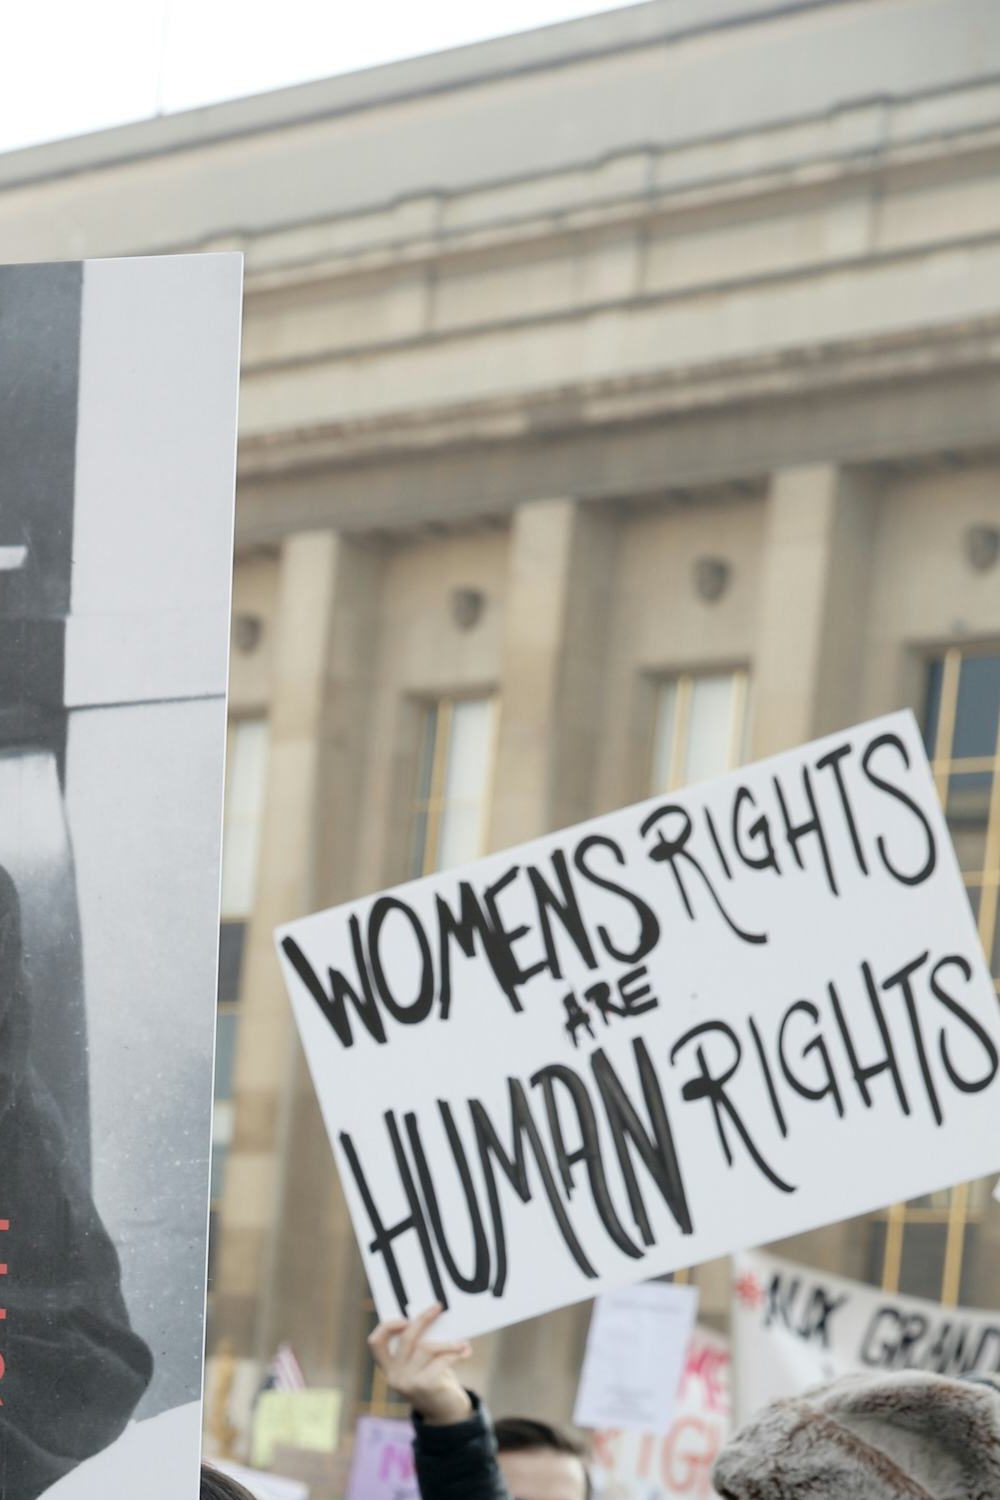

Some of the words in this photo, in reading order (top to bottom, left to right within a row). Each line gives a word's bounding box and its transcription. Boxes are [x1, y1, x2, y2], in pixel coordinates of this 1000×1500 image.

[281, 834, 661, 1048] WOMENS
[639, 733, 937, 945] RIGHTS
[562, 965, 659, 1048] ARE
[339, 1036, 694, 1320] HUMAN
[669, 951, 999, 1194] RIGHTS
